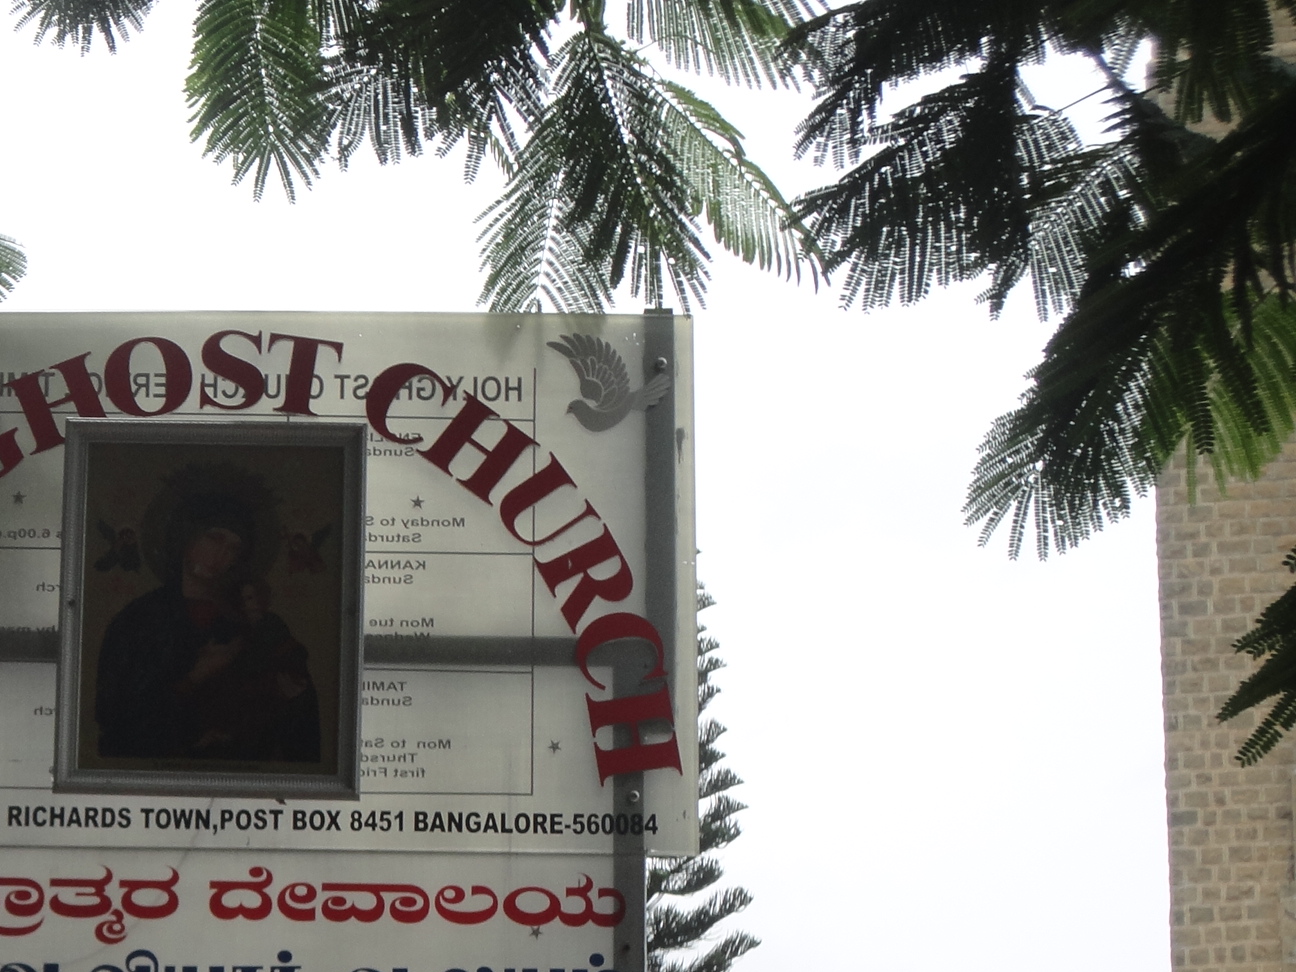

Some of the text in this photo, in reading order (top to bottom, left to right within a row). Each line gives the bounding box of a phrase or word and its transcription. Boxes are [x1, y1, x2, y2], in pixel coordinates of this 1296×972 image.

[364, 362, 683, 787] CHURCH
[6, 804, 132, 830] RICHARDS
[292, 809, 342, 832] BOX
[350, 810, 405, 833] 8451
[413, 811, 659, 836] BANGALORE-560084
[209, 866, 627, 928] ದೇವಾಲಯ
